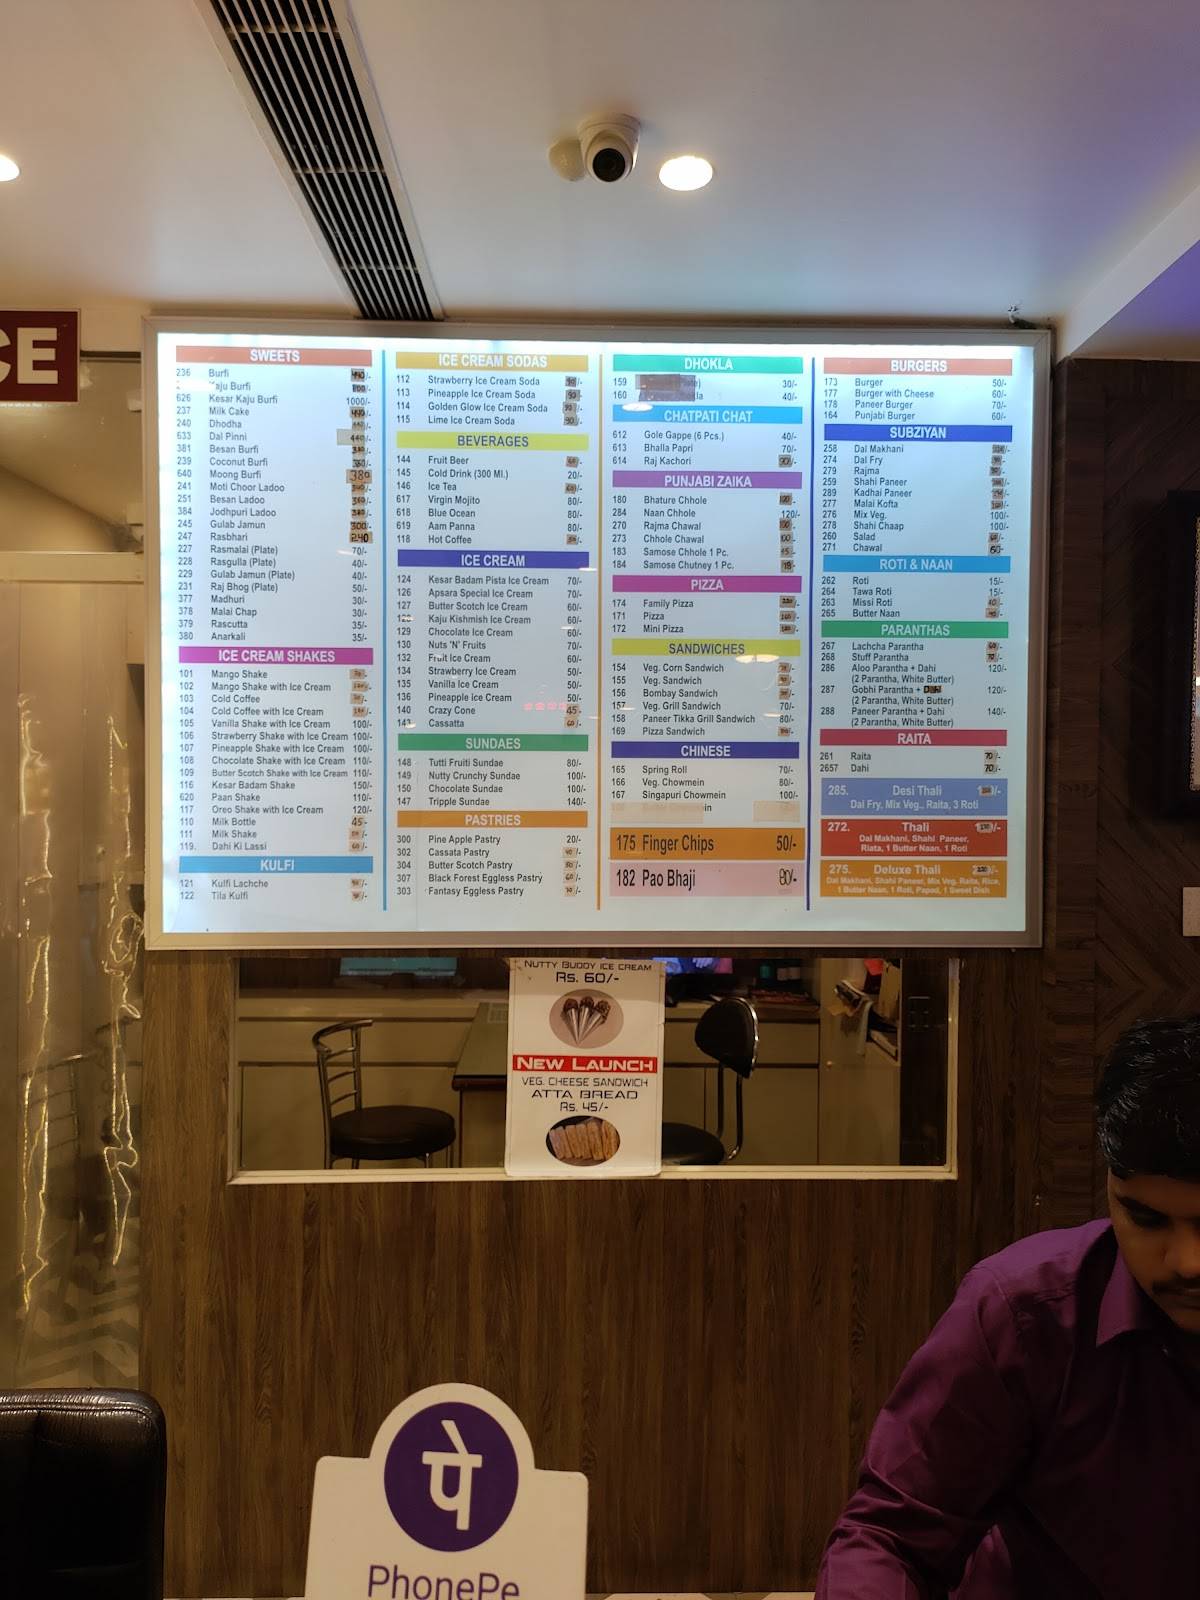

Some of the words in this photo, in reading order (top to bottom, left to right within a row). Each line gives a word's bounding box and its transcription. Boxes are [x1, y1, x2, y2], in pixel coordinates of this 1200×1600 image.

[250, 350, 300, 362] SWEETS
[438, 355, 458, 367] ICE
[461, 355, 503, 367] CREAM
[506, 355, 547, 368] SODAS
[684, 358, 733, 370] DHOKLA
[891, 360, 947, 372] BURGERS
[824, 389, 837, 397] 177
[855, 390, 883, 399] Burger
[886, 390, 901, 398] with
[904, 390, 934, 399] Cheese
[992, 390, 1007, 398] 60/-
[176, 394, 191, 402] 626
[209, 395, 233, 403] Kesar
[235, 395, 254, 404] Kaju
[257, 395, 277, 404] Burfi
[346, 397, 370, 406] 1000/-
[664, 410, 720, 422] CHATPATI
[723, 410, 753, 422] CHAT
[613, 431, 626, 439] 612
[644, 431, 663, 440] Gole
[665, 431, 692, 441] Gappe
[694, 431, 701, 441] (6
[704, 431, 724, 441] Pcs.)
[782, 432, 797, 441] 40/-
[890, 426, 947, 438] SUBZIYAN
[458, 436, 529, 447] BEVERAGES
[397, 469, 410, 477] 145
[428, 469, 446, 478] Cold
[449, 469, 471, 478] Drink
[474, 469, 492, 479] (300
[568, 471, 582, 479] 20/-
[664, 475, 715, 487] PUNJABI
[717, 476, 752, 488] ZAIKA
[428, 496, 452, 506] Virgin
[455, 496, 480, 506] Mojito
[613, 508, 626, 516] 284
[644, 509, 664, 517] Naan
[666, 509, 695, 517] Chhole
[781, 510, 800, 519] 120/-
[854, 511, 867, 519] Mix
[870, 511, 887, 520] Veg.
[990, 512, 1008, 520] 100/-
[178, 558, 192, 566] 228
[211, 558, 247, 567] Rasgulla
[250, 558, 276, 567] (Plate)
[352, 560, 367, 568] 40/-
[461, 555, 481, 566] ICE
[483, 555, 525, 567] CREAM
[880, 559, 907, 570] ROTI
[910, 559, 918, 570] &
[921, 559, 953, 570] NAAN
[691, 579, 724, 590] PIZZA
[822, 576, 835, 584] 262
[853, 576, 869, 584] Roti
[989, 577, 1003, 585] 15/-
[822, 587, 835, 595] 264
[853, 587, 873, 595] Tawa
[876, 587, 892, 595] Roti
[179, 595, 192, 603] 377
[211, 595, 244, 604] Madhuri
[352, 596, 367, 605] 30/-
[179, 620, 193, 628] 379
[211, 620, 247, 629] Rascutta
[352, 621, 367, 630] 35/-
[881, 625, 950, 636] PARANTHAS
[397, 641, 411, 649] 130
[428, 641, 446, 650] Nuts
[463, 641, 486, 650] Fruits
[567, 642, 582, 650] 70/-
[669, 643, 745, 655] SANDWICHES
[219, 650, 239, 662] ICE
[241, 650, 284, 662] CREAM
[287, 650, 336, 663] SHAKES
[821, 707, 835, 715] 288
[852, 707, 879, 716] Paneer
[881, 707, 917, 716] Parantha
[927, 707, 944, 716] Dahi
[988, 708, 1006, 716] 140/-
[465, 738, 521, 750] SUNDAES
[897, 734, 931, 744] RAITA
[681, 745, 730, 757] CHINESE
[642, 766, 668, 776] Spring
[671, 766, 687, 774] Roll
[398, 772, 411, 780] 149
[429, 772, 450, 782] Nutty
[452, 772, 487, 782] Crunchy
[490, 772, 520, 780] Sundae
[567, 772, 586, 780] 100/-
[212, 781, 235, 790] Kesar
[238, 781, 268, 790] Badam
[270, 781, 295, 790] Shake
[353, 782, 372, 790] 150/-
[612, 778, 625, 786] 166
[642, 778, 659, 788] Veg.
[662, 778, 704, 787] Chowmein
[828, 785, 848, 795] 285.
[893, 785, 914, 796] Desi
[917, 785, 942, 796] Thali
[465, 814, 521, 826] PASTRIES
[827, 822, 850, 831] 272.
[902, 822, 929, 832] Thali
[397, 835, 411, 843] 300
[428, 835, 447, 843] Pine
[449, 835, 472, 845] Apple
[474, 835, 500, 845] Pastry
[567, 835, 581, 843] 20/-
[616, 835, 636, 851] 175
[643, 836, 678, 855] Finger
[681, 835, 714, 855] Chips
[776, 835, 797, 851] 50/-
[260, 859, 294, 871] KULFI
[829, 865, 851, 874] 275.
[874, 865, 911, 874] Deluxe
[913, 865, 940, 875] Thali
[616, 869, 635, 886] 182
[642, 870, 663, 886] Pao
[667, 869, 696, 890] Bhaji
[525, 960, 556, 969] NUTTY
[562, 961, 595, 969] BUDDY
[600, 962, 614, 970] ICE
[556, 972, 578, 983] Rs.
[585, 973, 619, 983] 60/-
[517, 1057, 563, 1070] NEW
[573, 1058, 652, 1071] LAUNCH
[522, 1077, 544, 1086] VEG.
[549, 1078, 589, 1086] CHEESE
[594, 1078, 648, 1087] SANDWICH
[532, 1090, 572, 1098] ATTA
[580, 1090, 637, 1099] BREAD
[560, 1102, 578, 1112] Rs.
[583, 1102, 608, 1112] 45/-
[422, 1420, 482, 1530] पे
[368, 1565, 520, 1600] PhonePe
